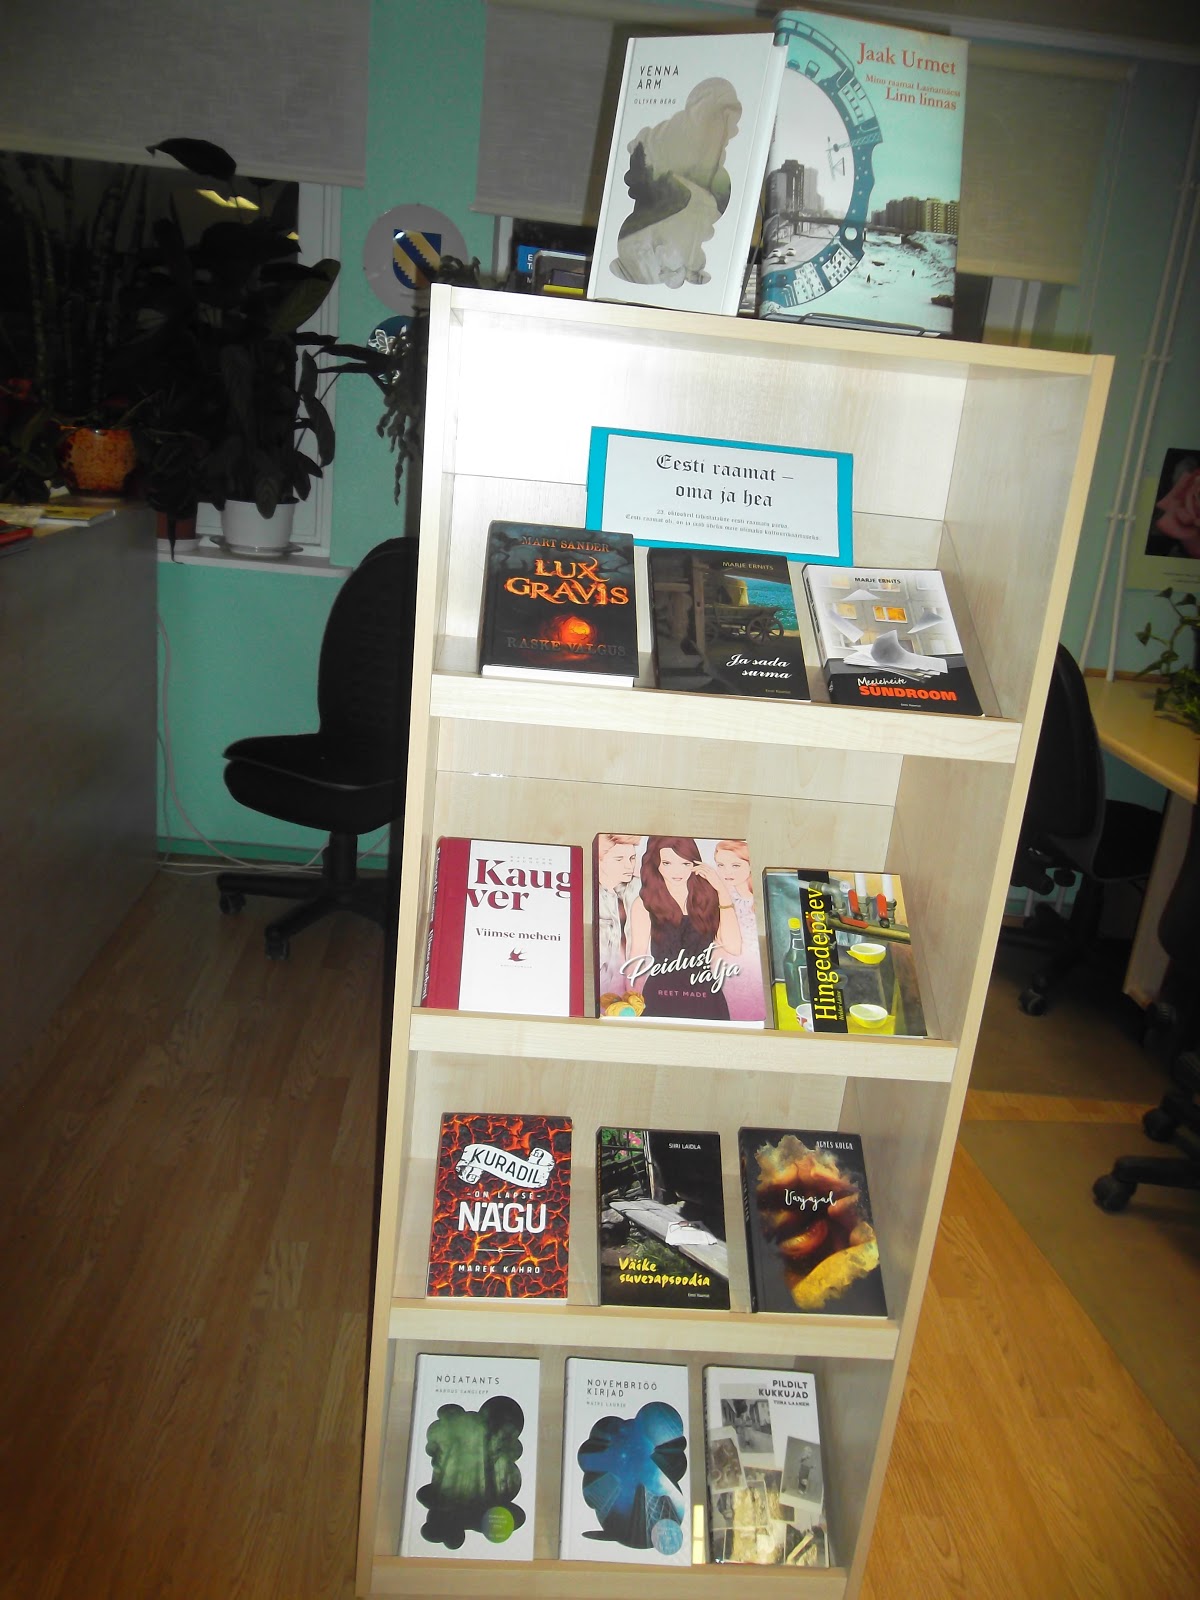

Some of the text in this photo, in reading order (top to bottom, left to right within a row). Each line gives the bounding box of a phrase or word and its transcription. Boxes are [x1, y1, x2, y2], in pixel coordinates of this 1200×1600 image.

[857, 42, 957, 75] Jaak Urmet
[640, 65, 679, 76] VENNA
[637, 79, 662, 89] ARM
[885, 87, 957, 111] Linn linnas
[656, 453, 705, 474] Eesti
[712, 463, 777, 482] raamat
[675, 484, 773, 507] oma ja hea
[521, 535, 610, 553] MART SANDER
[535, 556, 610, 583] LUX
[722, 561, 775, 571] MARJE ERNITS
[506, 636, 627, 658] RASKE VALGUS
[726, 653, 792, 668] Ja sada
[741, 667, 793, 680] surma
[475, 858, 571, 899] Kaug
[467, 888, 530, 911] ver
[476, 927, 561, 942] Viimse meheni
[805, 887, 839, 1021] Hingedepäev
[619, 943, 720, 987] Peidust
[690, 957, 741, 994] välja
[658, 989, 708, 998] REET MADE
[470, 1147, 542, 1184] KURADIL
[458, 1201, 547, 1233] NÄGU
[458, 1265, 541, 1275] MAREK KAHRO
[619, 1257, 657, 1273] Väike
[619, 1273, 710, 1288] suverapsoodia
[586, 1387, 624, 1398] KIRJAD
[758, 1388, 809, 1399] KUKKUJAD
[772, 1379, 808, 1390] PILDILT
